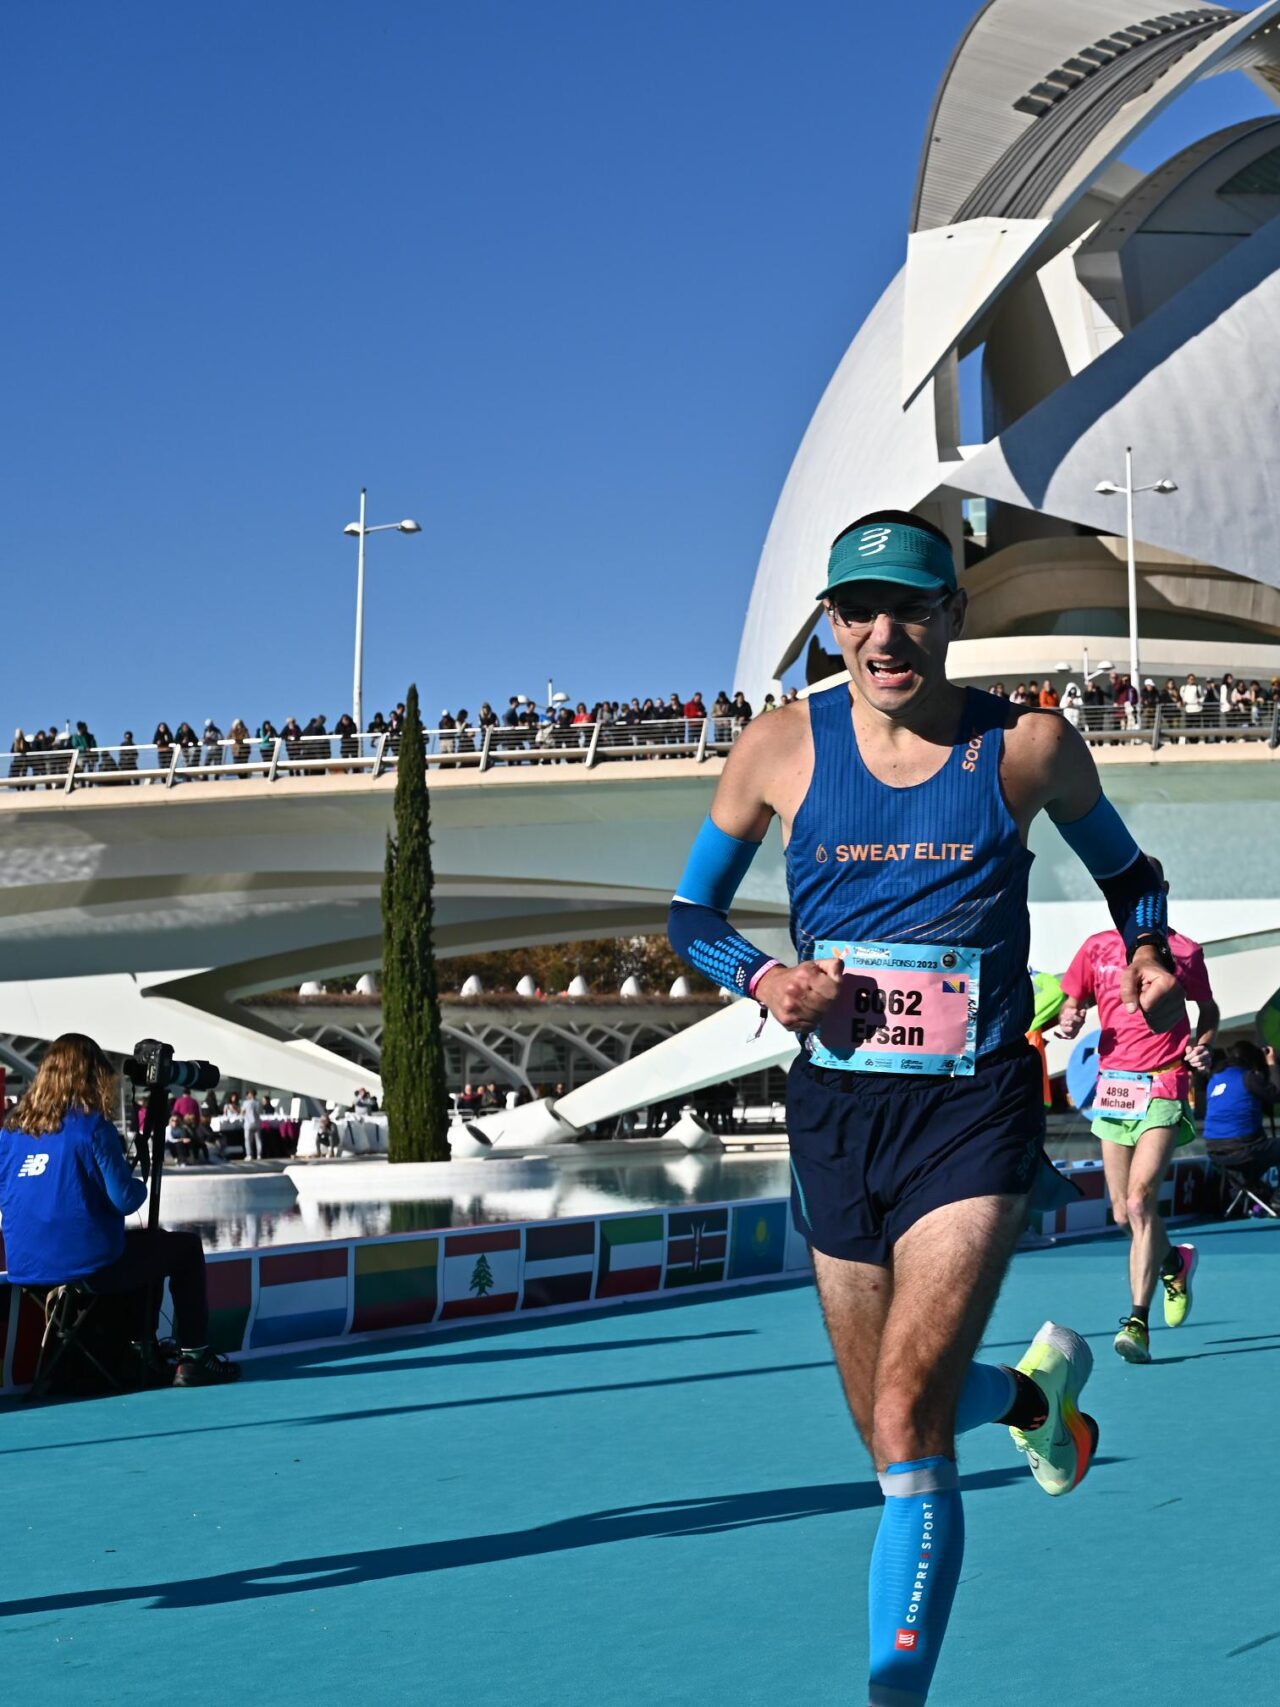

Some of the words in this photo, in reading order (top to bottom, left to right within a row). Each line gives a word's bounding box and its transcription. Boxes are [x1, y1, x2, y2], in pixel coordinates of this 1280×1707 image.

[836, 843, 911, 862] SWEAT
[914, 842, 974, 861] ELITE
[916, 960, 938, 969] 2023
[854, 987, 923, 1016] 6062
[852, 1018, 925, 1046] Ersan
[1106, 1086, 1129, 1098] 4898
[1100, 1097, 1135, 1110] Michael
